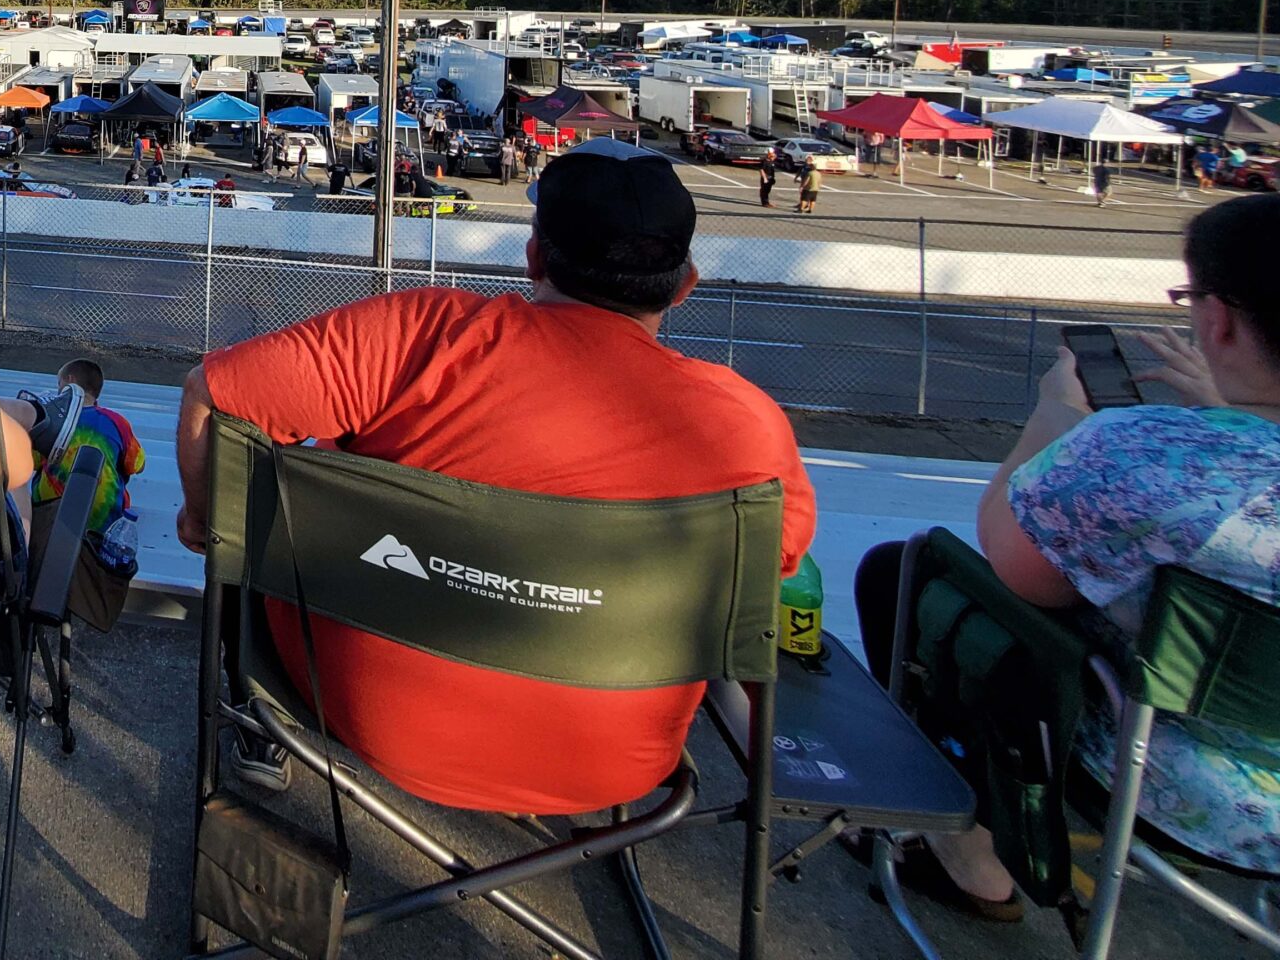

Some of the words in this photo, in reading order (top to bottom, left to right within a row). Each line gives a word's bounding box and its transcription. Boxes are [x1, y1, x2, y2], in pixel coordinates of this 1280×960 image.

[428, 555, 520, 594] OZARK
[523, 580, 603, 605] TRAIL
[446, 579, 505, 601] OUTDOOR
[509, 596, 582, 613] EQUIPMENT
